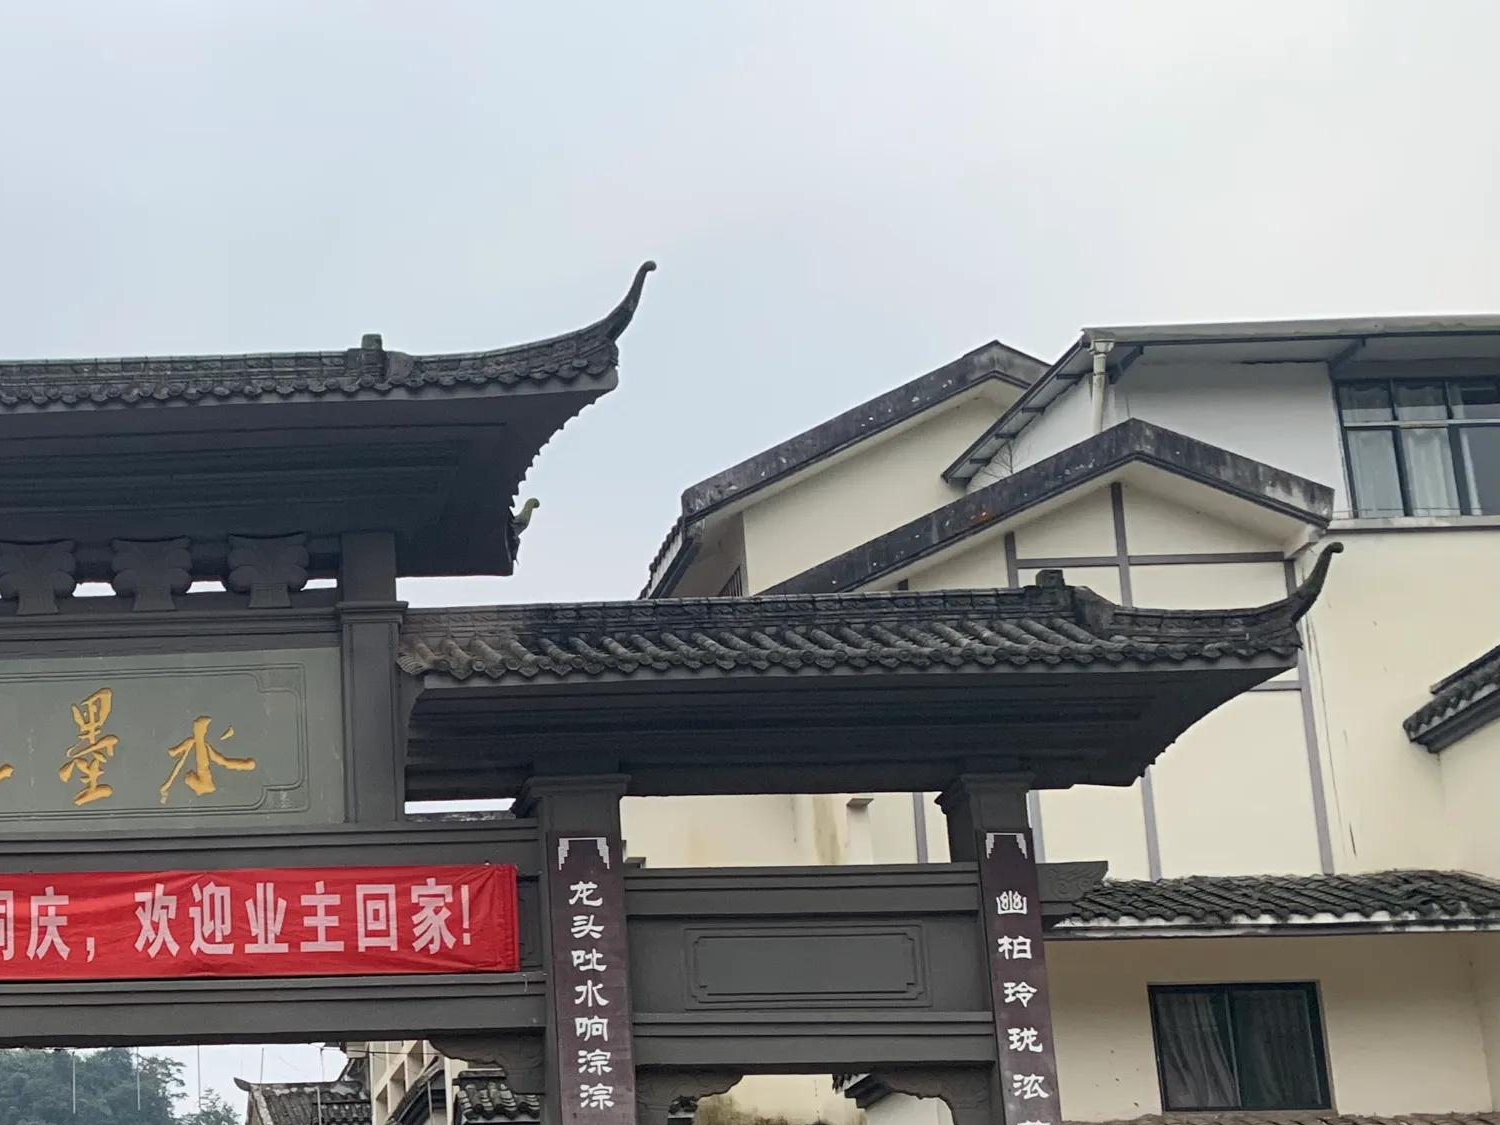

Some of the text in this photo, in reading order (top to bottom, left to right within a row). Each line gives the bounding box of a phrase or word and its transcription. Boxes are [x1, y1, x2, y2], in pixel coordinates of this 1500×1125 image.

[567, 880, 616, 1111] 龙头吐水响淙淙
